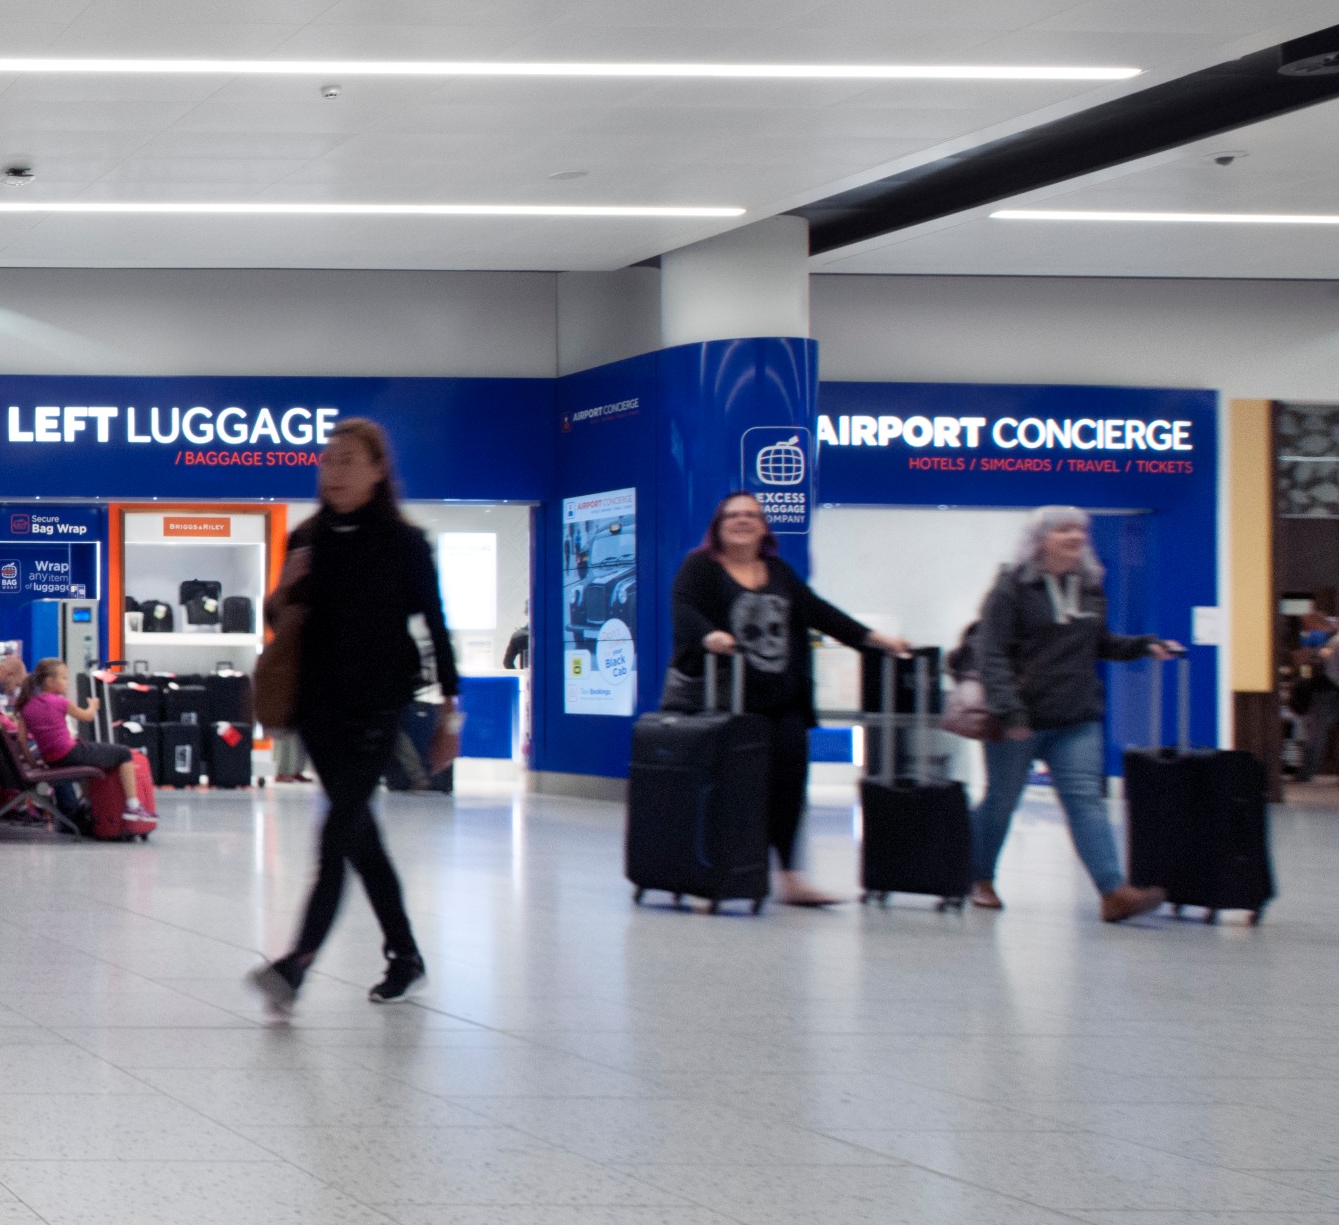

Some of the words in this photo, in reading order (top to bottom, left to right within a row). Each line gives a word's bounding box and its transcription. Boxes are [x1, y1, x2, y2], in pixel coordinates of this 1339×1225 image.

[573, 407, 603, 422] AIRPORT
[603, 398, 639, 414] CONCIERGE
[8, 406, 118, 442] LEFT
[127, 407, 339, 445] LUGGAGE
[817, 415, 986, 448] AIRPORT
[992, 417, 1193, 451] CONCIERGE
[185, 451, 263, 466] BAGGAGE
[266, 451, 323, 466] STORA
[909, 457, 965, 471] HOTELS
[980, 458, 1052, 472] SIMCARDS
[1067, 459, 1120, 472] TRAVEL
[1136, 460, 1193, 473] TICKETS
[756, 492, 805, 503] EXCESS
[763, 504, 805, 513] AGGAGE
[31, 515, 59, 523] Secure
[765, 514, 805, 523] OMPANY
[32, 523, 54, 535] Bag
[57, 523, 87, 535] Wrap
[35, 560, 69, 573] Wrap
[28, 572, 48, 583] any
[48, 574, 69, 582] item
[25, 582, 33, 590] of
[605, 655, 626, 669] Black
[613, 666, 627, 677] Cab
